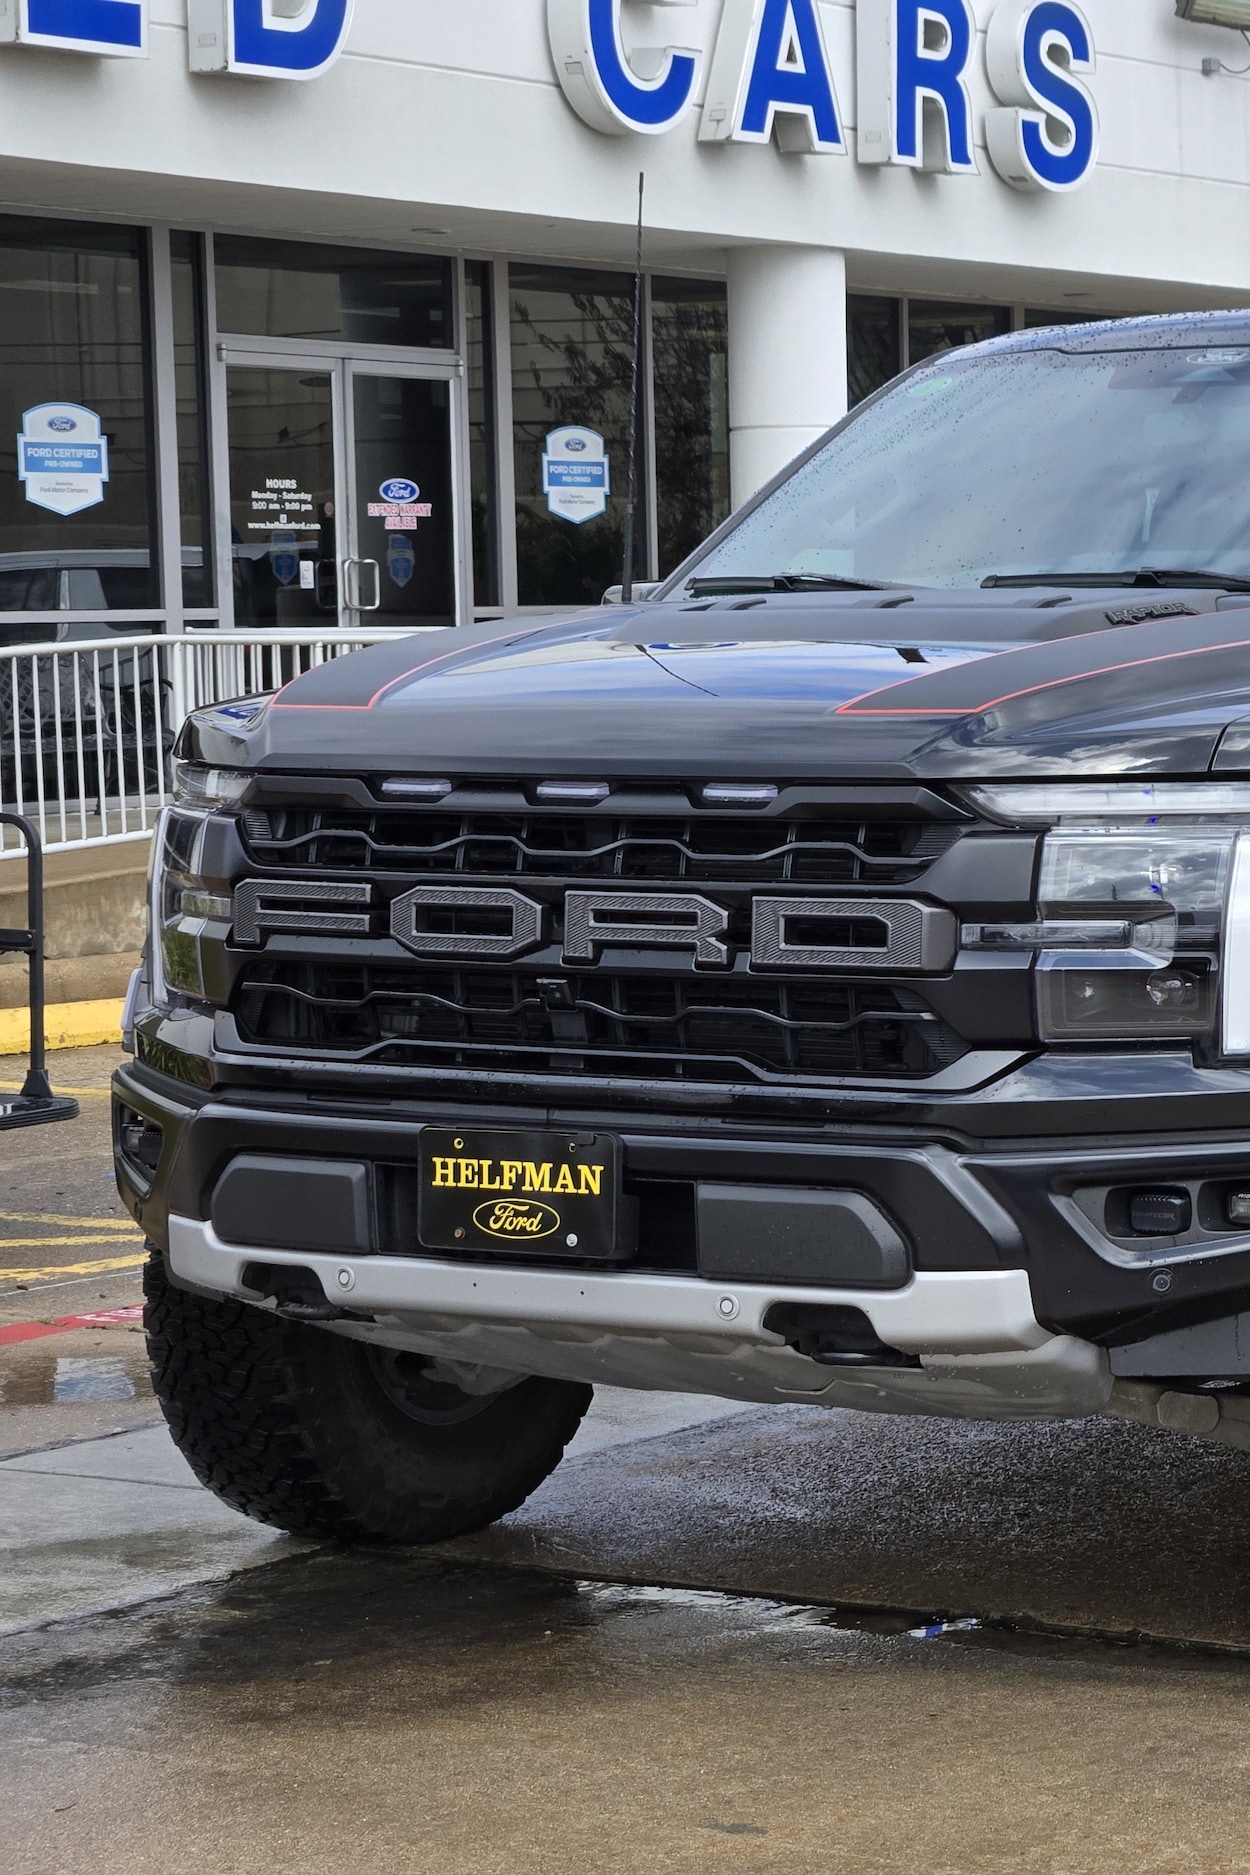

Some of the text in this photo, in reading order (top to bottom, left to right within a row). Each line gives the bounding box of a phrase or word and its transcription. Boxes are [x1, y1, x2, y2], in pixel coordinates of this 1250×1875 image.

[572, 0, 1097, 191] CARS
[27, 447, 98, 458] FORD CERTIFIED
[549, 465, 603, 475] FORD CERTIFIED
[266, 479, 297, 489] HOURS
[388, 483, 410, 498] Ford
[252, 491, 278, 500] Monday
[283, 492, 312, 501] Saturday
[301, 504, 313, 512] pm
[368, 503, 432, 516] EXTENDED WARRANTY
[385, 517, 417, 529] AVAILABLE
[1104, 602, 1199, 624] RAPTOR
[232, 877, 956, 974] FORD
[431, 1156, 604, 1195] HELFMAN
[489, 1202, 543, 1232] Ford
